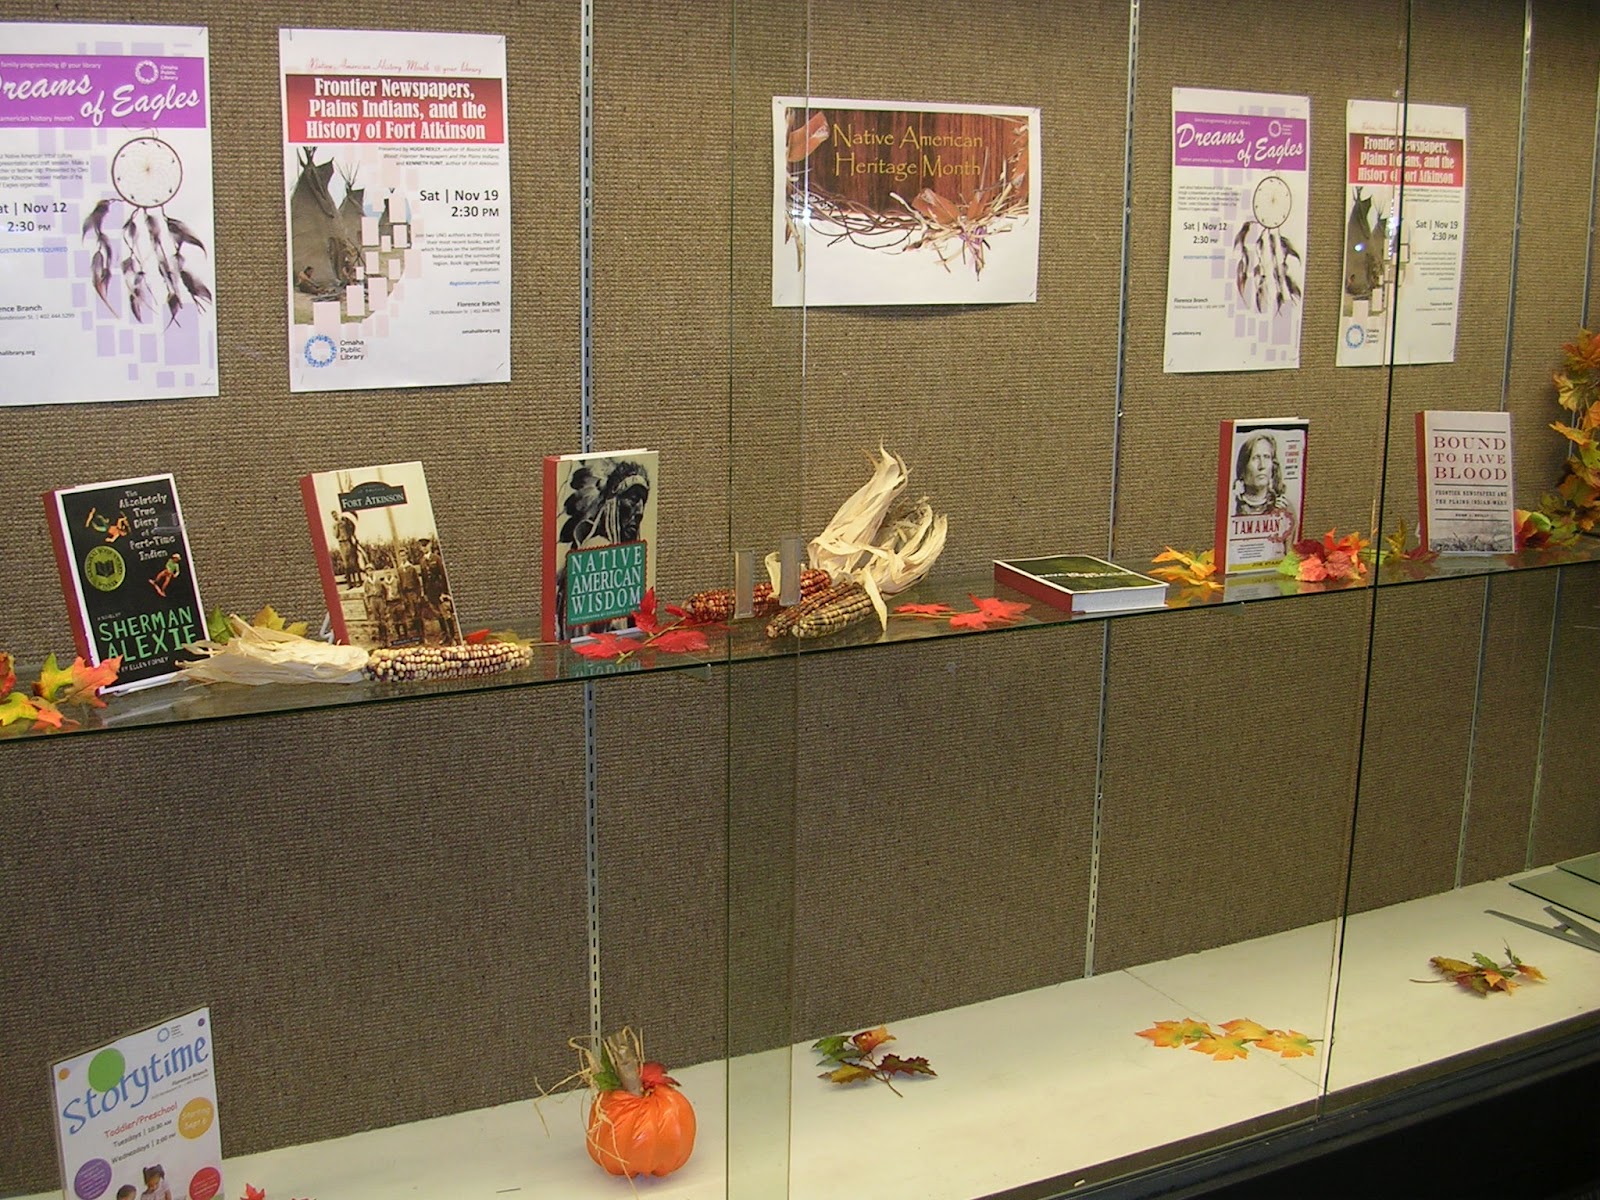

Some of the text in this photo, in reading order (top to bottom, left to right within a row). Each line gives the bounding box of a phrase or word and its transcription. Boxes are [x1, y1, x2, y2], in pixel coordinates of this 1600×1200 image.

[0, 73, 93, 100] reams
[314, 78, 475, 99] Frontier Newspapers,
[80, 84, 200, 127] of Eagles
[309, 99, 487, 120] Plains Indians, and the
[306, 121, 486, 140] History of Fort Atkinson
[834, 124, 982, 149] Native American
[1176, 123, 1246, 148] Dreams
[1363, 136, 1398, 151] Frontie
[1237, 138, 1304, 167] of Eagles
[1360, 152, 1388, 166] Plains
[1424, 156, 1440, 169] and
[1441, 156, 1455, 169] the
[835, 153, 981, 181] Heritage Month
[1358, 168, 1388, 184] History
[1419, 171, 1454, 184] Atkinson
[420, 190, 440, 201] Sat
[455, 190, 480, 201] Nov
[484, 190, 499, 201] 19
[24, 203, 49, 213] Nov
[53, 202, 67, 213] 12
[451, 206, 500, 218] 2:30 PM
[7, 221, 35, 232] 2:30
[1183, 222, 1227, 231] Sat Nov 12
[1416, 220, 1458, 229] Sat Nov 19
[1193, 235, 1209, 244] 2:30
[1432, 232, 1447, 241] 2:30
[1434, 436, 1506, 450] BOUND
[1434, 453, 1506, 464] TO HAVE
[1434, 467, 1507, 480] BLOOD
[133, 507, 156, 517] True
[133, 518, 158, 529] Diary
[129, 535, 176, 550] Part-Time
[139, 549, 168, 561] Indian
[571, 545, 642, 575] NATIVE
[571, 566, 642, 595] AMERICAN
[571, 586, 641, 615] WISDOM
[98, 606, 193, 642] SHERMAN
[108, 624, 197, 662] ALEXIE
[63, 1036, 209, 1135] Storytime
